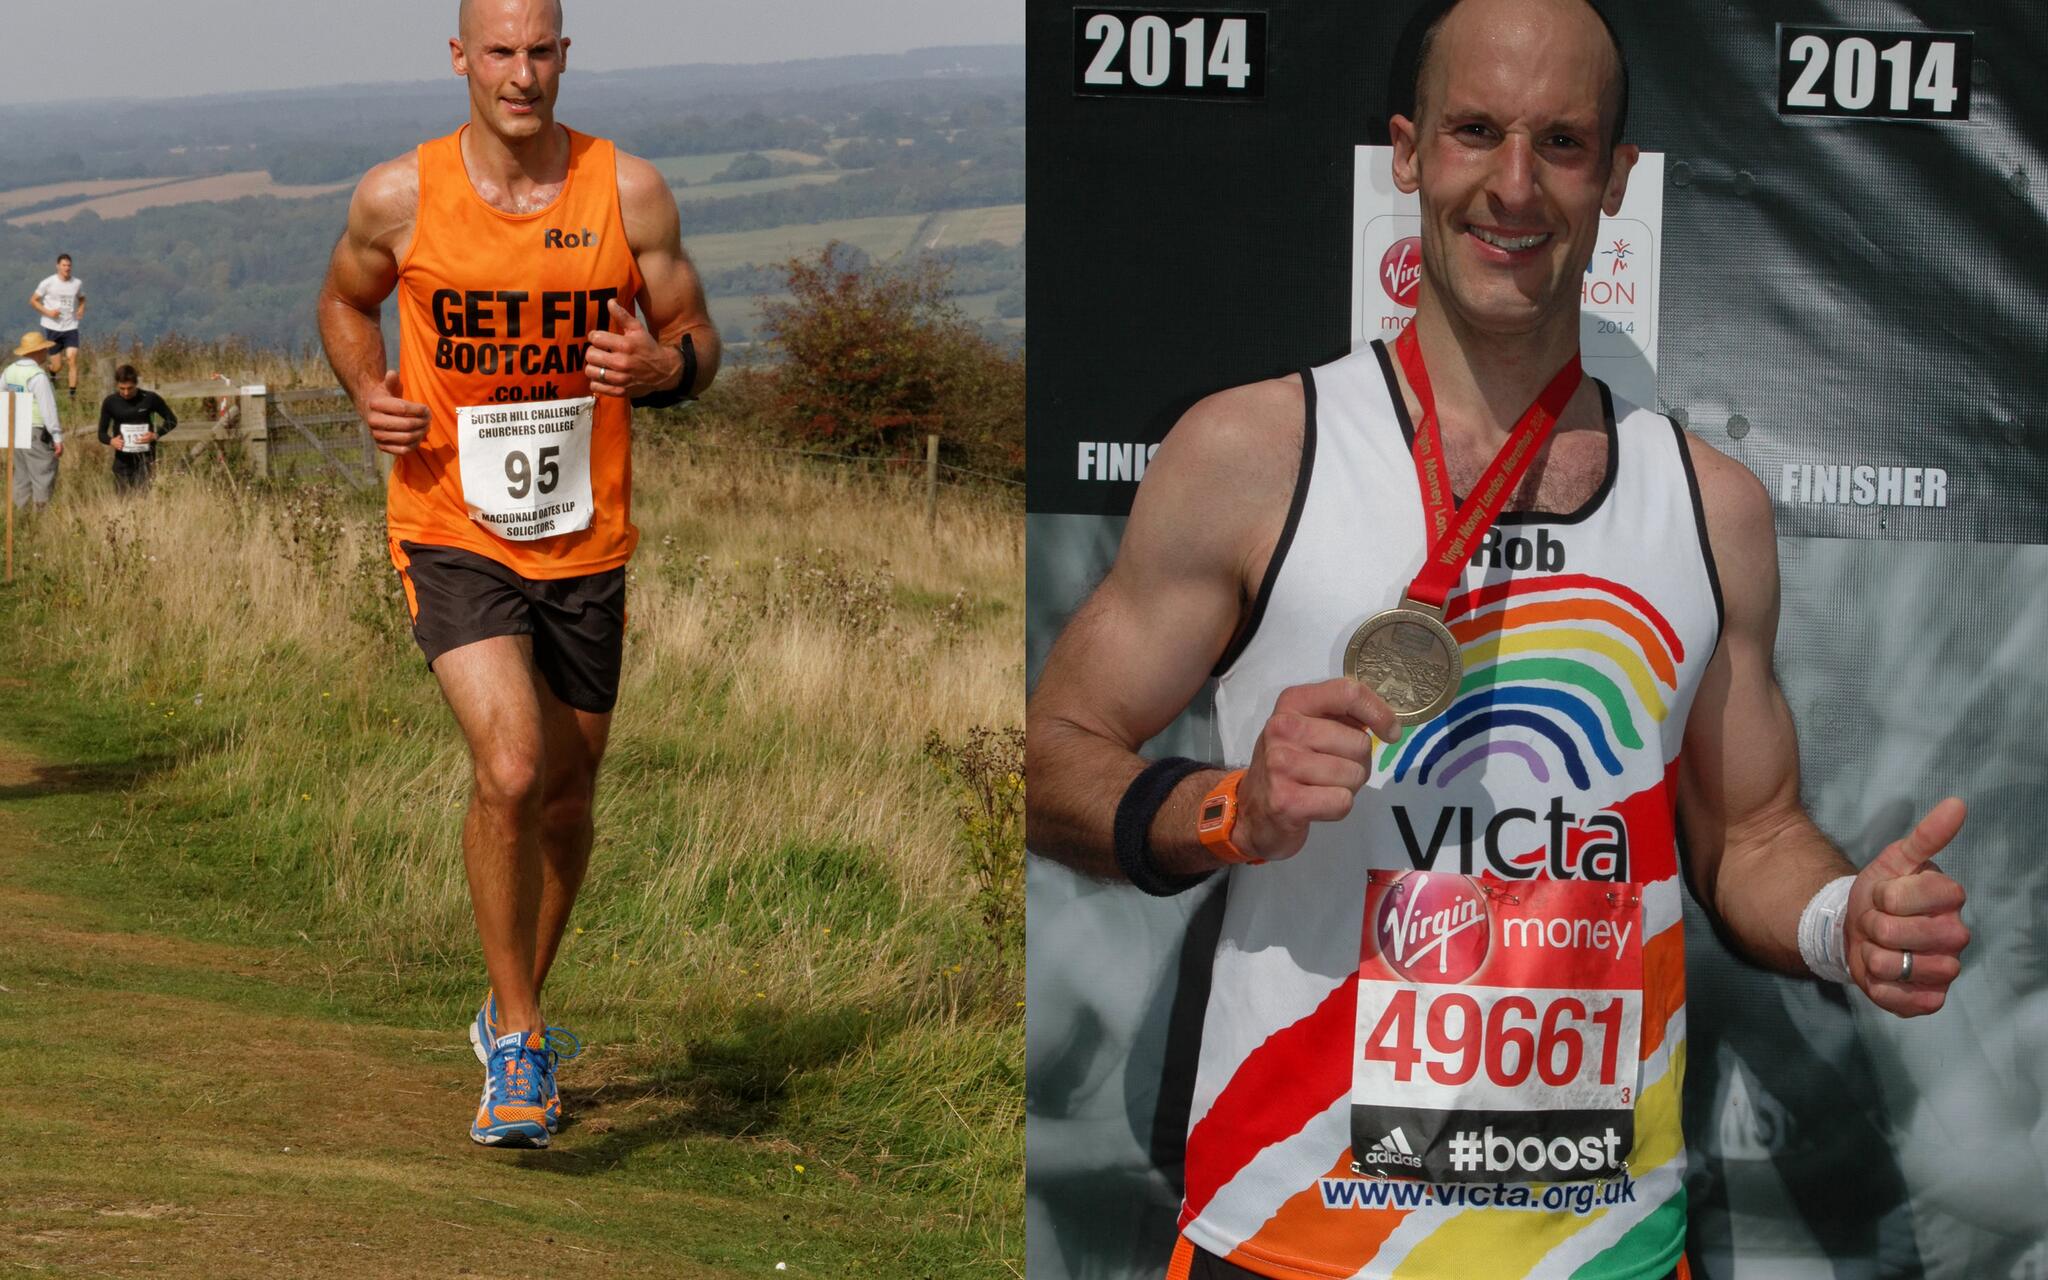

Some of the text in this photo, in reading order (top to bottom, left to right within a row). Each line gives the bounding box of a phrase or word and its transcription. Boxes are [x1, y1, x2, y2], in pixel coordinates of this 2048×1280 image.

[1084, 14, 1250, 88] 2014
[1787, 35, 1957, 112] 2014
[544, 228, 598, 249] Rob
[432, 288, 618, 338] GET FIT
[1597, 321, 1634, 334] 2014
[435, 337, 591, 376] BOOTCAM
[488, 381, 560, 401] .co.uk
[478, 420, 574, 439] CHURCHERS COLLEGE
[510, 410, 529, 422] HILL
[531, 405, 580, 421] CHALLENGE
[504, 446, 560, 499] 95
[1078, 442, 1160, 481] FINI
[1782, 464, 1947, 507] FINISHER
[482, 501, 575, 524] MACDONALD OATES LLP
[506, 520, 555, 537] SOLICITORS
[1435, 508, 1447, 540] Lon
[1439, 537, 1464, 566] Virgin
[1458, 504, 1488, 540] Money
[1478, 472, 1505, 508] London
[1470, 526, 1566, 573] Rob
[1384, 875, 1486, 973] Virgin
[1503, 918, 1632, 960] money
[1364, 990, 1624, 1087] 49661
[1621, 1088, 1630, 1103] 3
[1365, 1150, 1422, 1168] adidas
[1449, 1126, 1621, 1172] #boost
[1321, 1176, 1637, 1213] www.victa.org.uk
